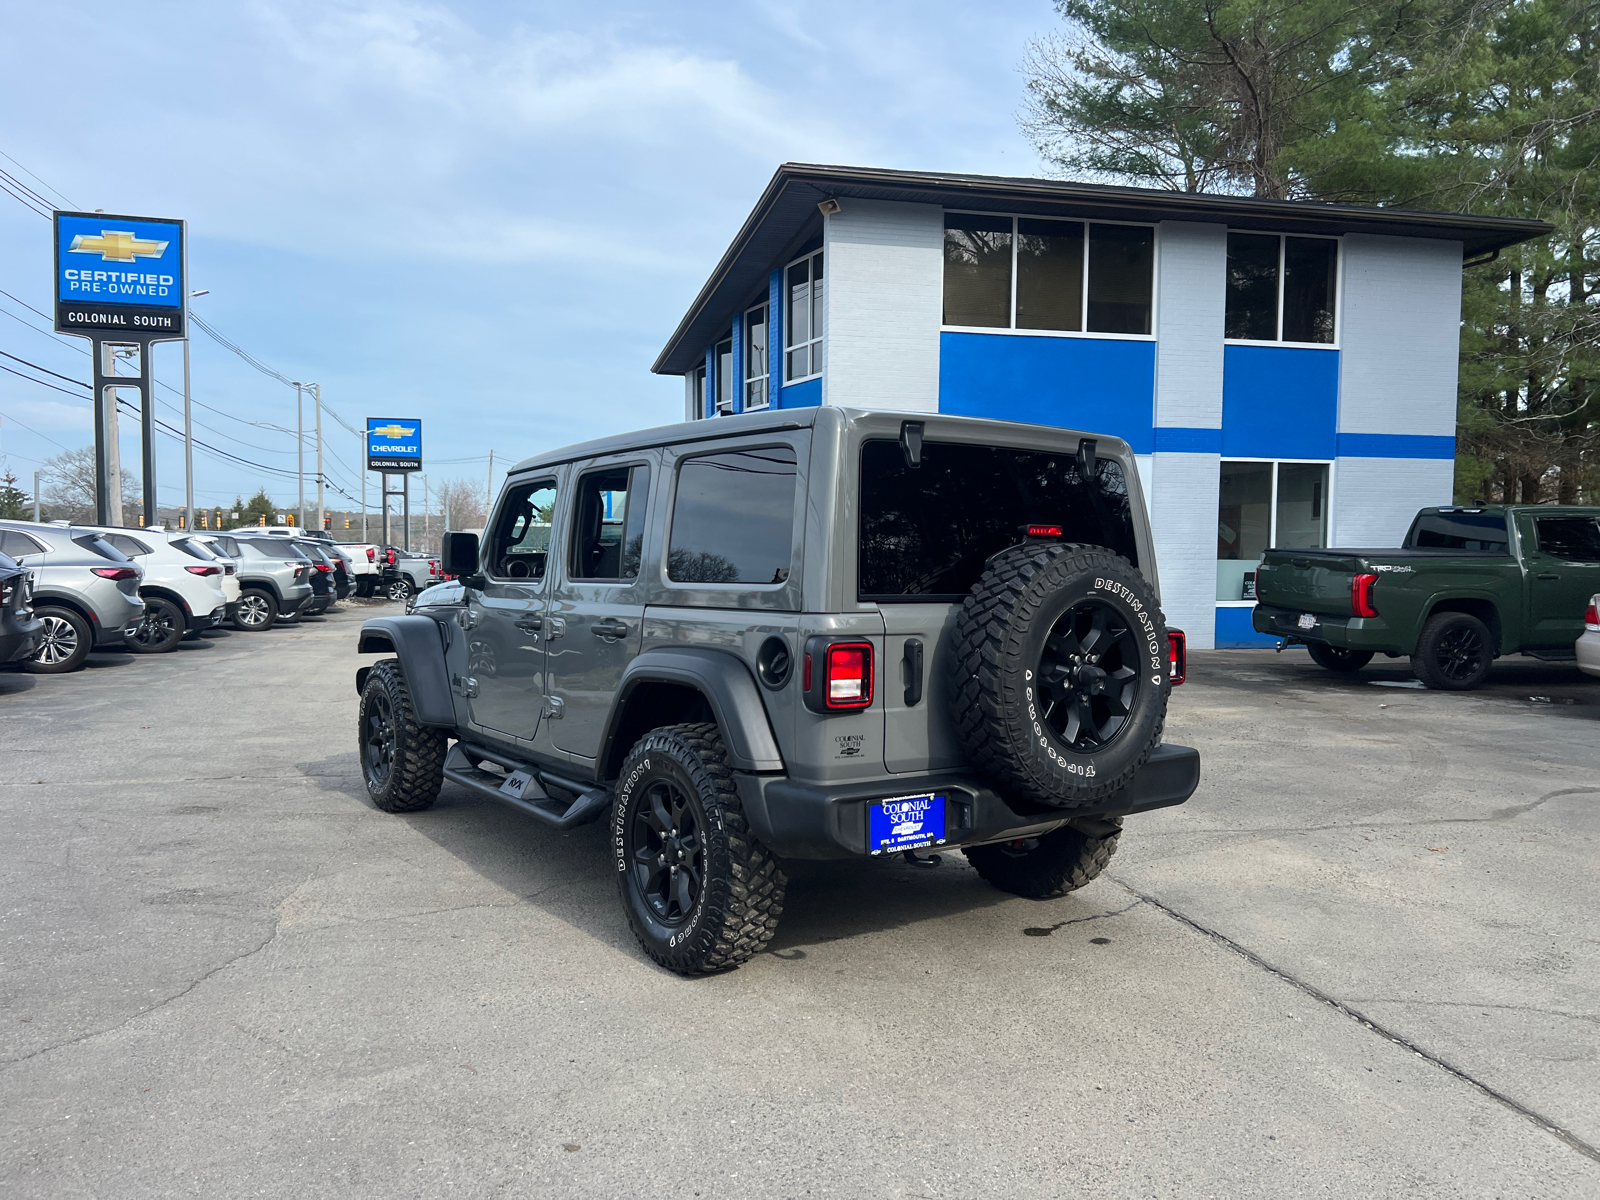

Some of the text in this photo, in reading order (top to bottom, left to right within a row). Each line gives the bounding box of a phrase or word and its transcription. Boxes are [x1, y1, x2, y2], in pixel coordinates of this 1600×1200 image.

[65, 269, 174, 286] CERTIFIED
[70, 281, 168, 296] PRE-OWNED
[68, 312, 171, 327] COLONIAL SOUTH
[371, 445, 418, 453] CHEVROLET
[1094, 577, 1161, 670] DESTINATION
[834, 735, 866, 743] COLONIAL
[883, 800, 931, 815] COLONIAL
[616, 765, 645, 872] DESTINATION
[890, 810, 924, 824] SOUTH
[886, 844, 914, 853] COLONIAL
